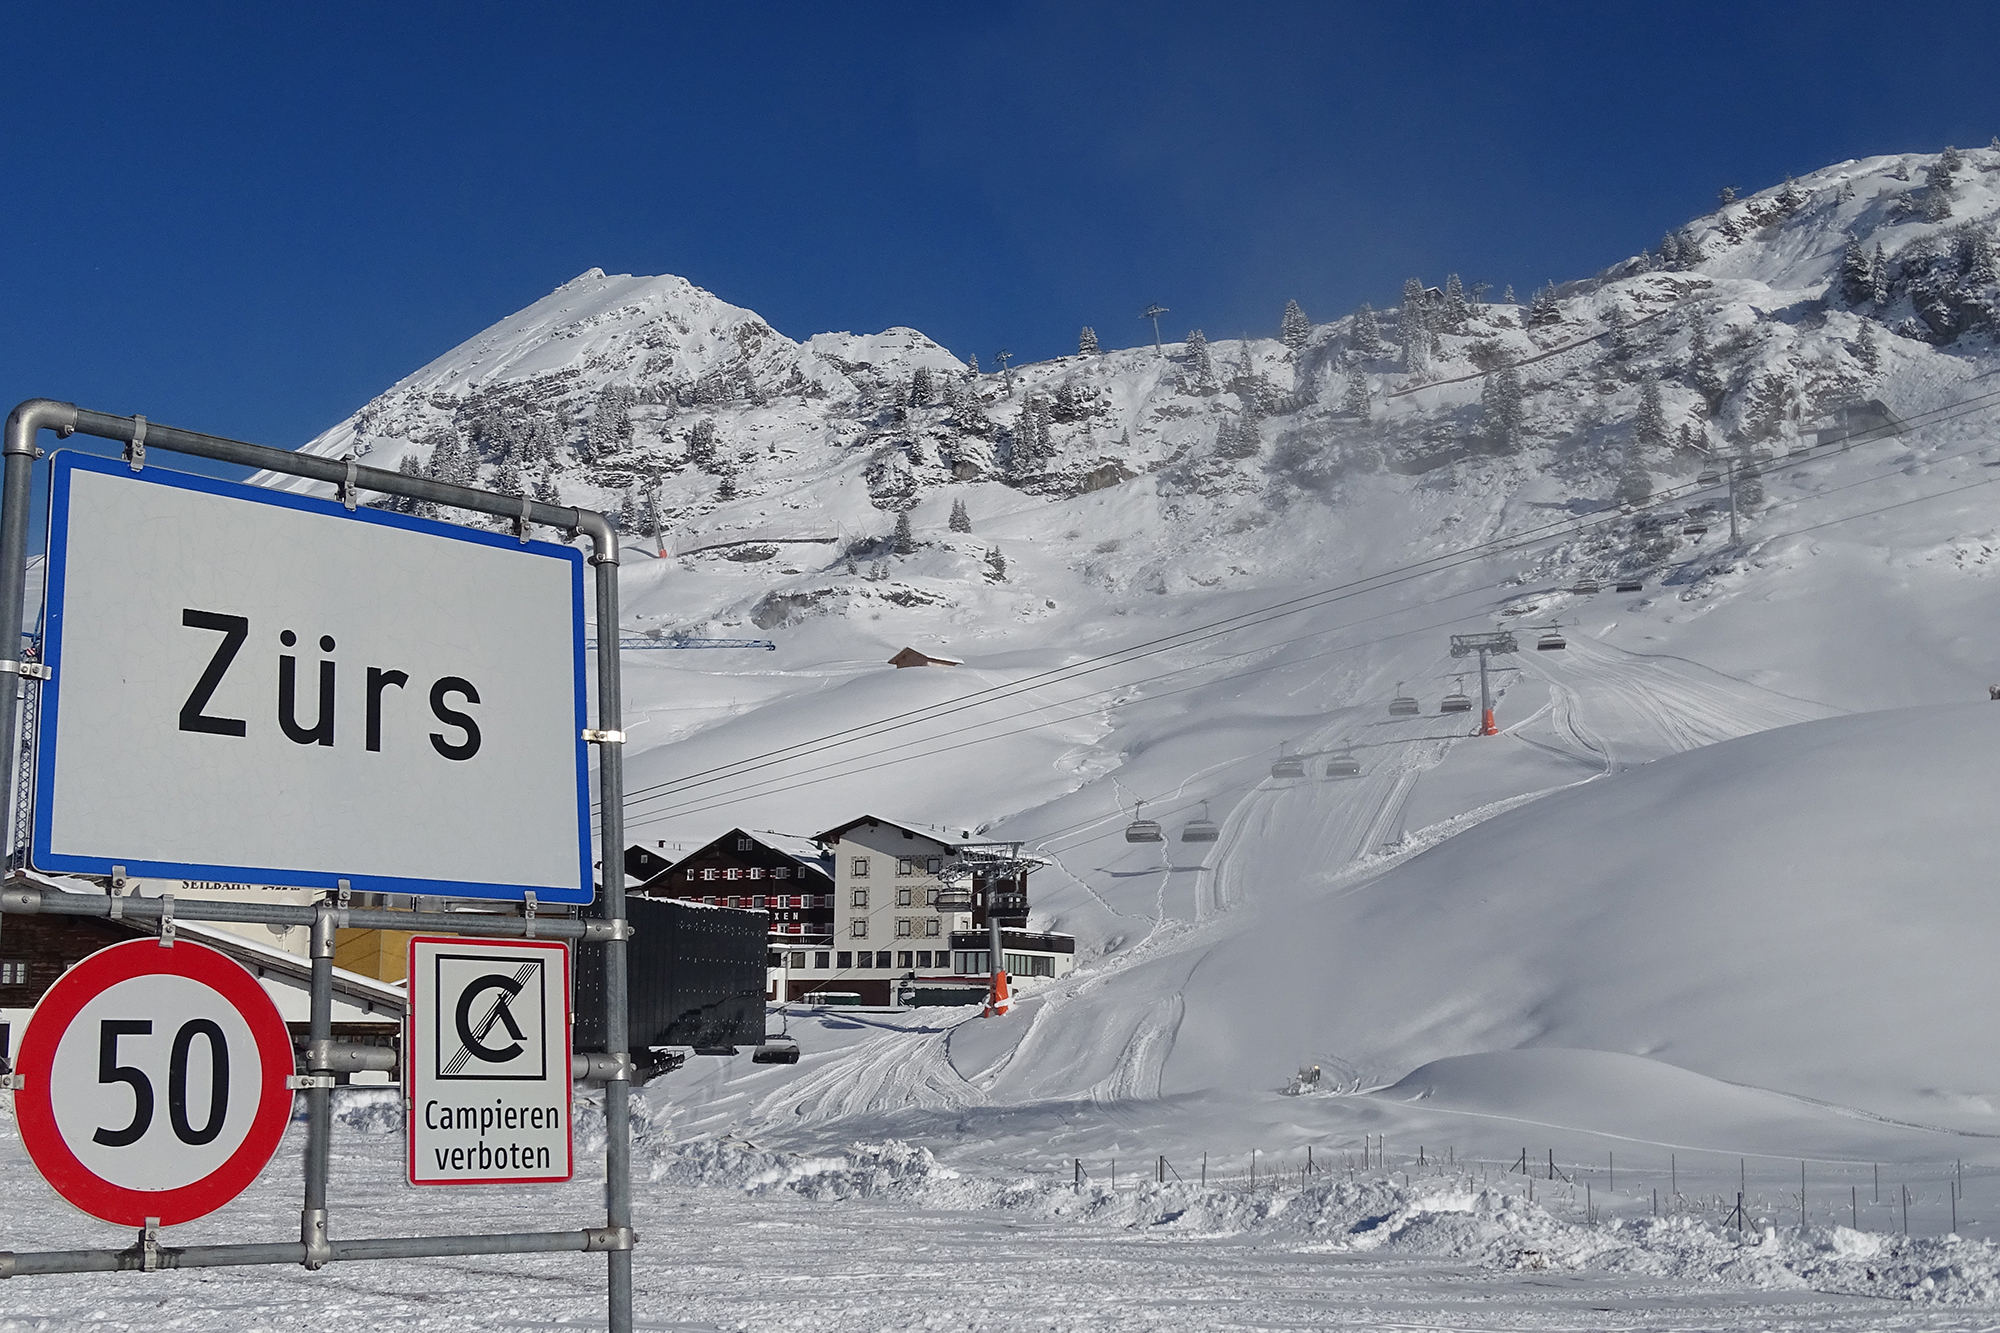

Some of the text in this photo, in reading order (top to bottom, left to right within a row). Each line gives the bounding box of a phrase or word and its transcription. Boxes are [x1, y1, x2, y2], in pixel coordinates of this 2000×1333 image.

[178, 608, 482, 761] Zürs
[92, 1018, 230, 1148] 50
[425, 1098, 559, 1137] Campieren
[434, 1140, 550, 1171] verboten
